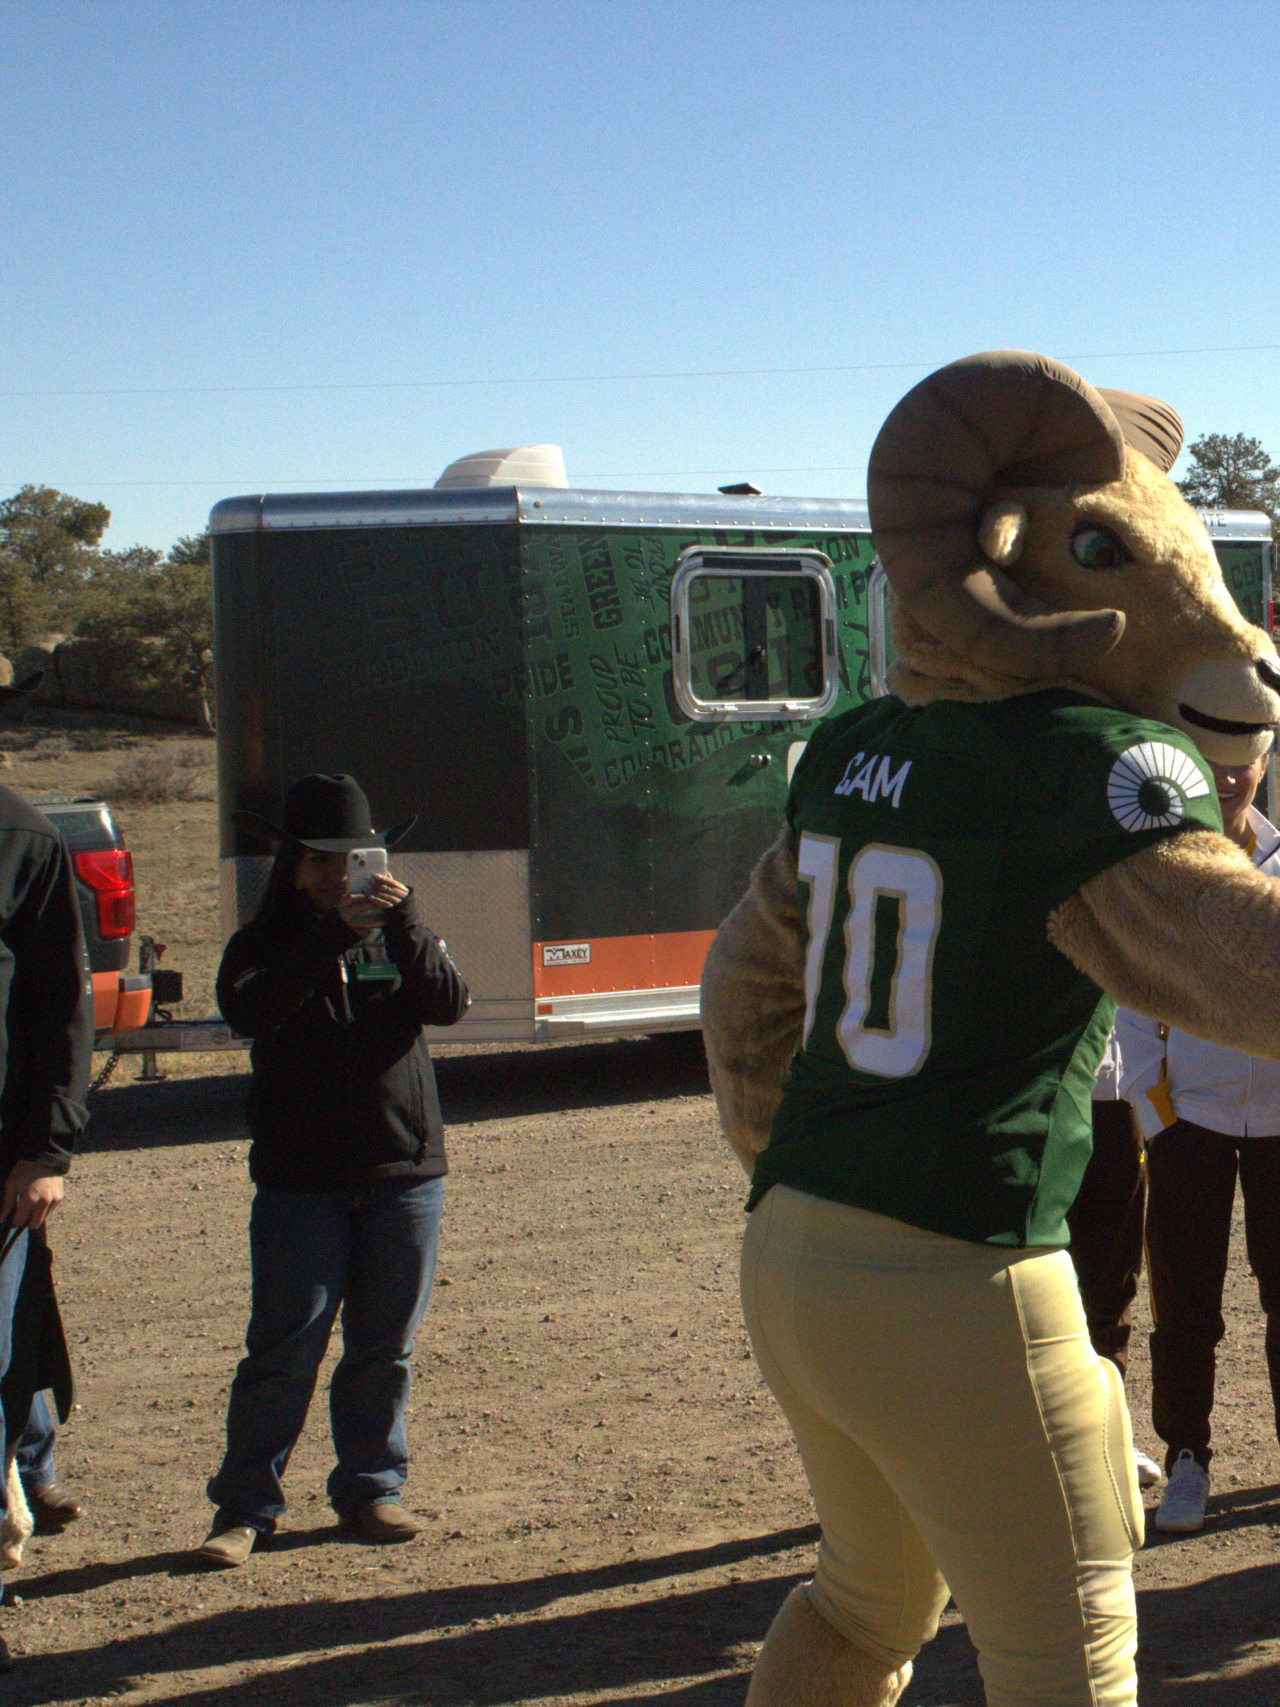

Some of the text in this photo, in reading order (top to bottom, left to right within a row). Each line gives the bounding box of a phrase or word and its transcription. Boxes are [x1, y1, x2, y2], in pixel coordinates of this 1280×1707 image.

[589, 654, 632, 744] PROUD
[625, 699, 657, 739] TO
[835, 751, 913, 808] CAM
[546, 948, 588, 961] MAXEY
[797, 829, 943, 1078] 10
